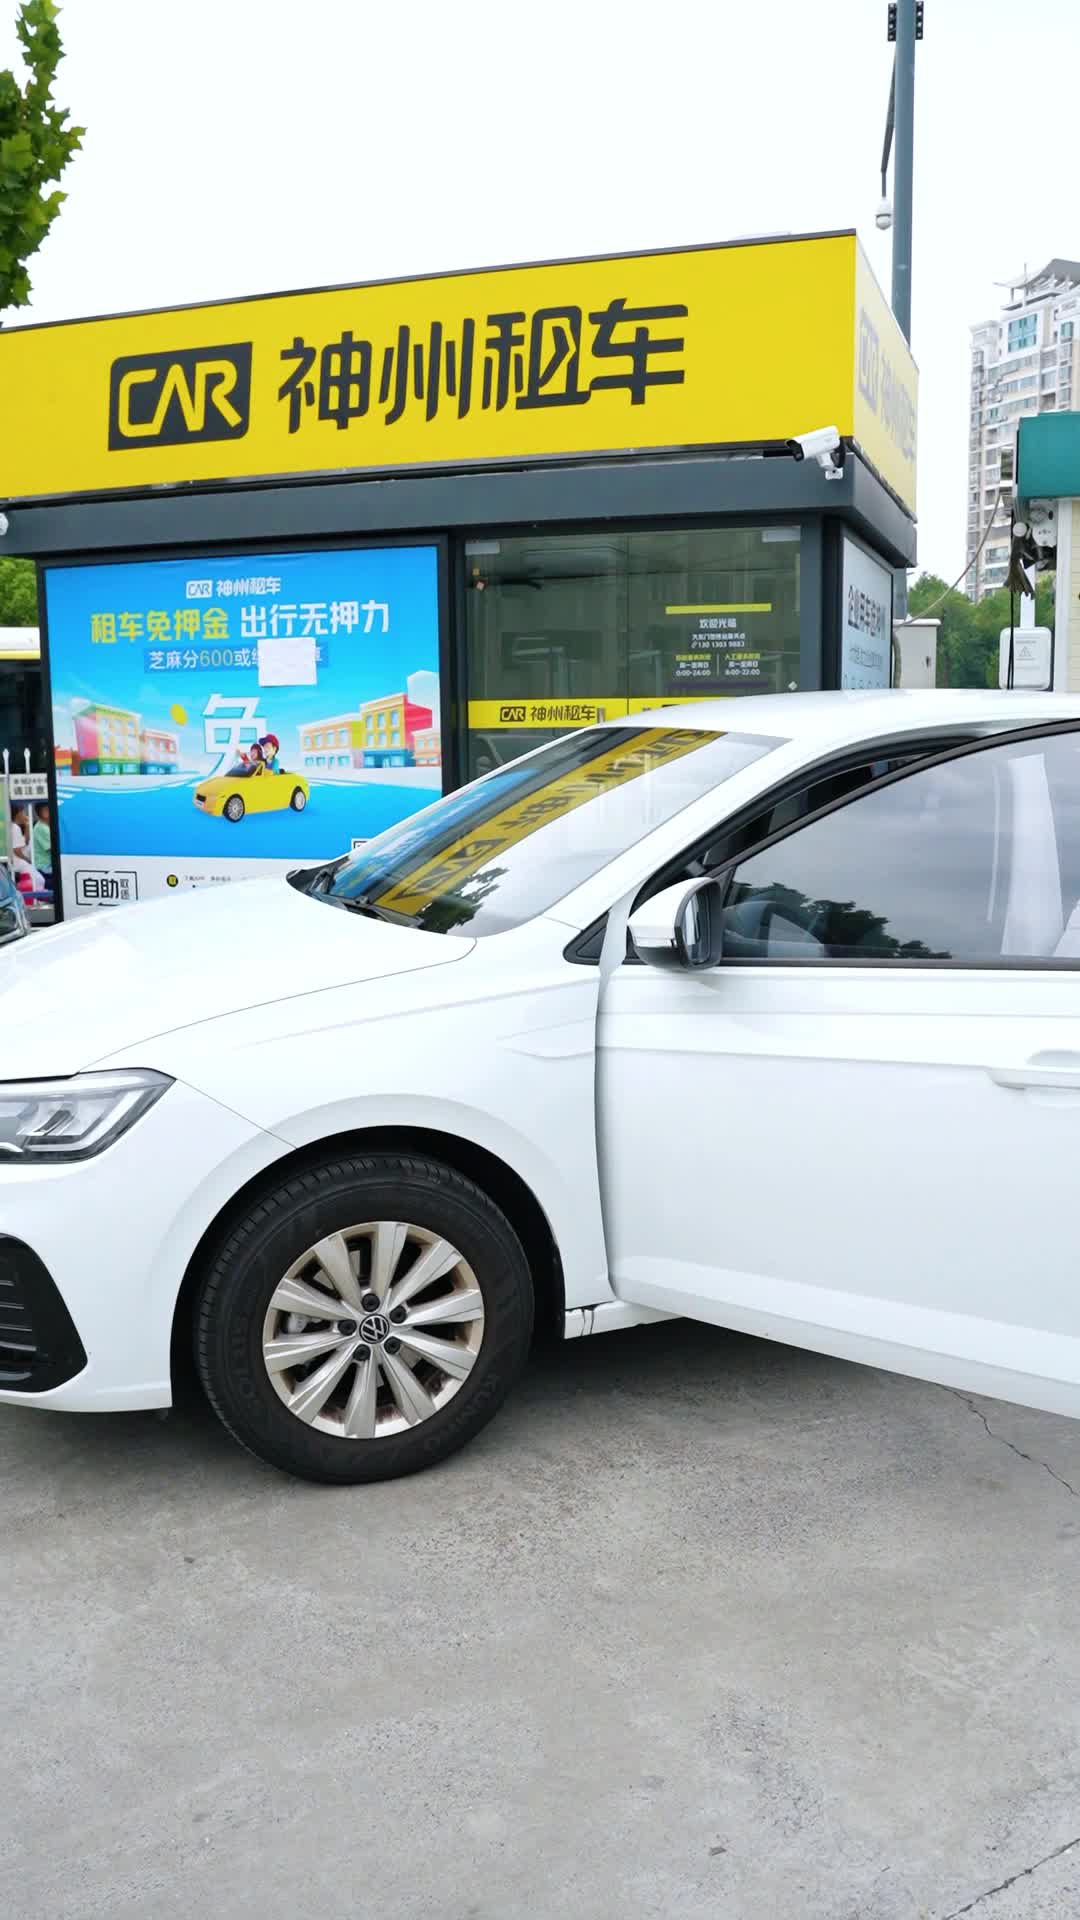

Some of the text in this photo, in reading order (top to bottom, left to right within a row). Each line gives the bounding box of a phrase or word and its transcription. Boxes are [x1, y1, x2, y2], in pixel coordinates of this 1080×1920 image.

[115, 297, 689, 441] CAR 神州租车
[187, 576, 281, 598] CAR 神州租车
[90, 599, 390, 644] 租车免押金 出行无押力
[501, 704, 596, 721] CAR 神州租车
[202, 692, 267, 777] 免
[83, 878, 119, 899] 自助
